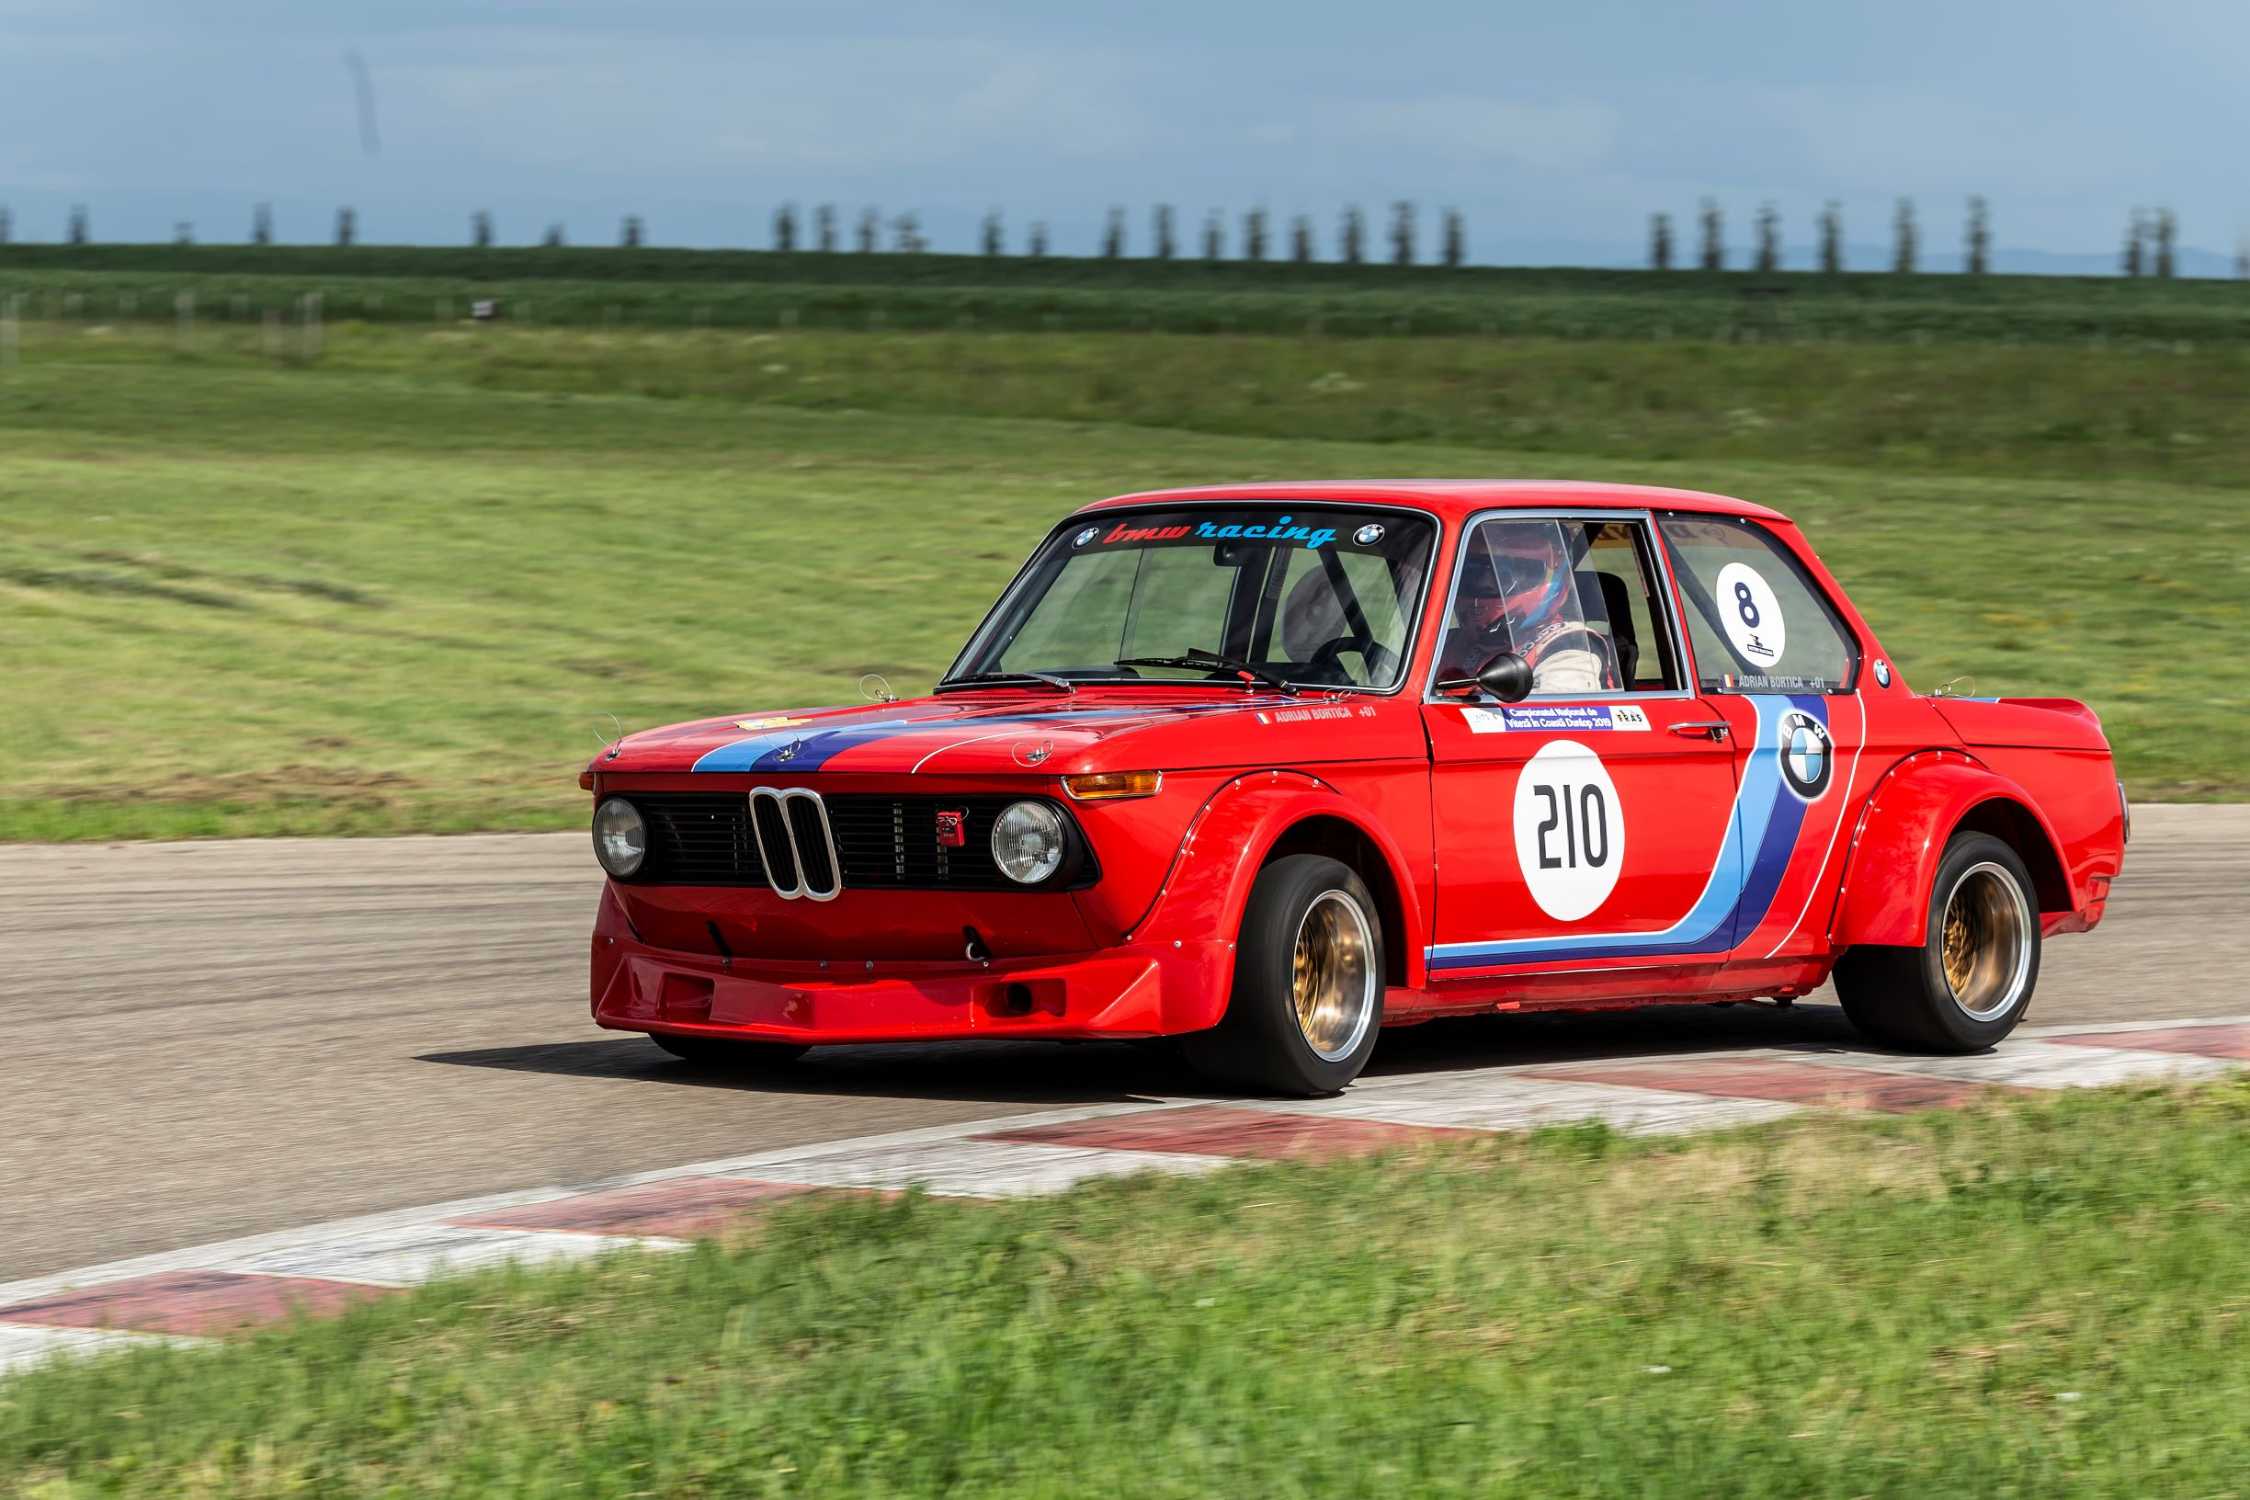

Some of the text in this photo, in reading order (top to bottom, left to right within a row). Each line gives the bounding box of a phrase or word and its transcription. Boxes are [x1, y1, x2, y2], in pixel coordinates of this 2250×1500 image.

[1103, 523, 1192, 544] bmw
[1195, 515, 1337, 549] racing
[1734, 581, 1760, 629] 8
[1738, 674, 1769, 688] ADRIAN
[1770, 674, 1804, 688] BORTICA
[1275, 710, 1312, 723] ADRIAN
[1311, 707, 1352, 720] BORTICA
[1782, 714, 1825, 740] BMW
[1533, 784, 1608, 869] 210
